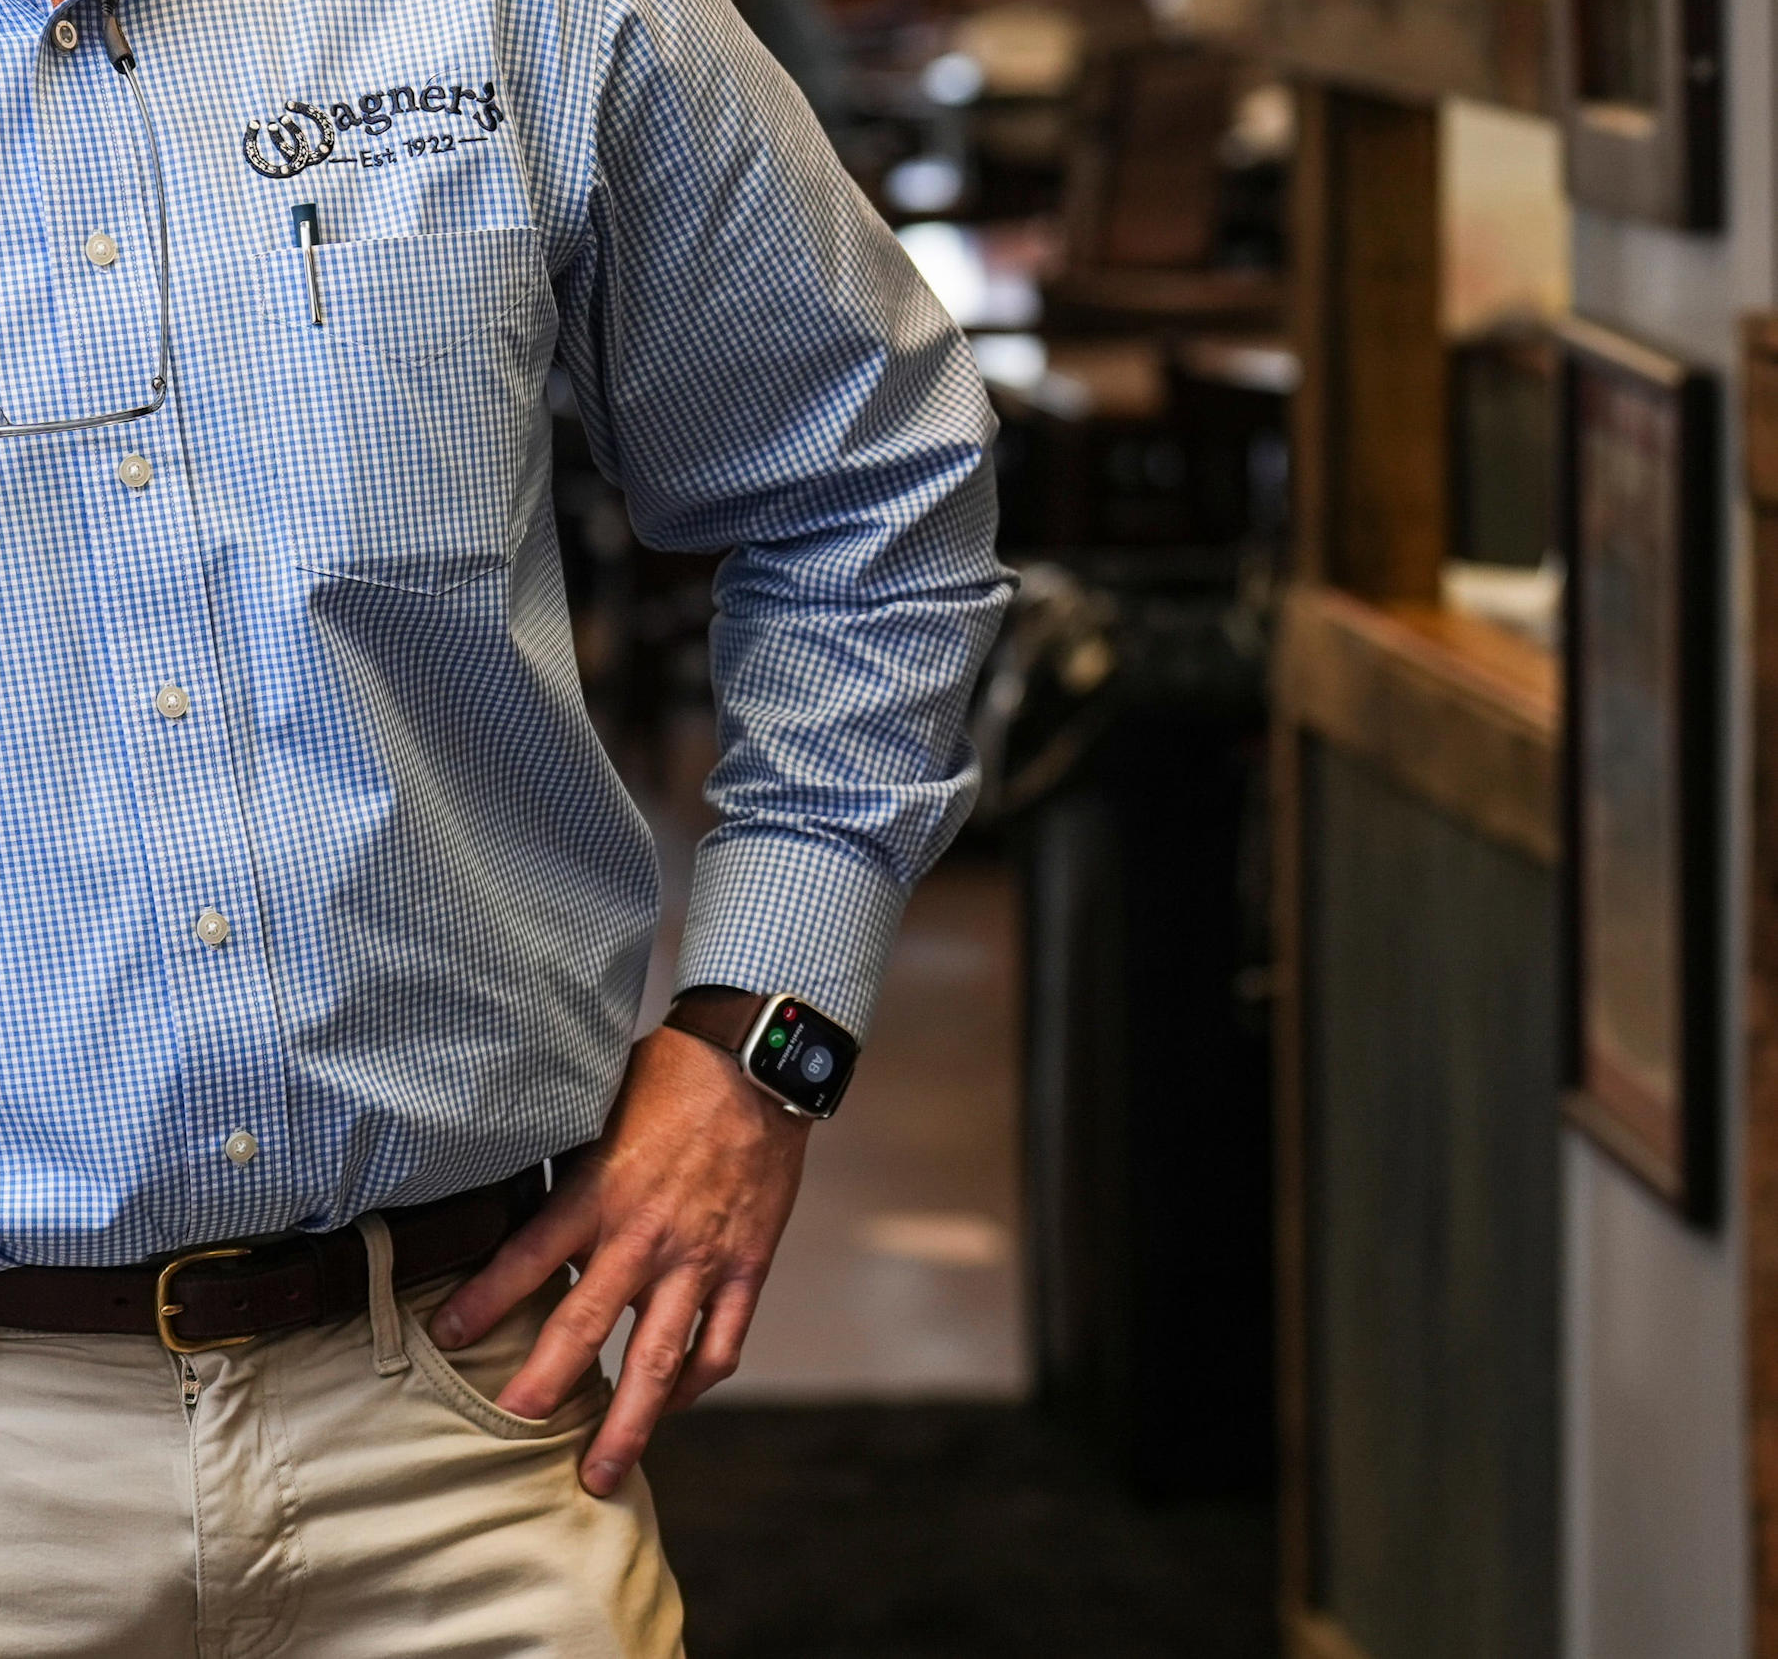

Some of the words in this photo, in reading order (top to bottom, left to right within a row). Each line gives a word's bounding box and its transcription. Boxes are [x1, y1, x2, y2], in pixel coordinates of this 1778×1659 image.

[243, 81, 504, 179] Wagner's
[359, 148, 398, 169] Est.
[402, 134, 456, 158] 1922
[808, 1052, 823, 1074] AB
